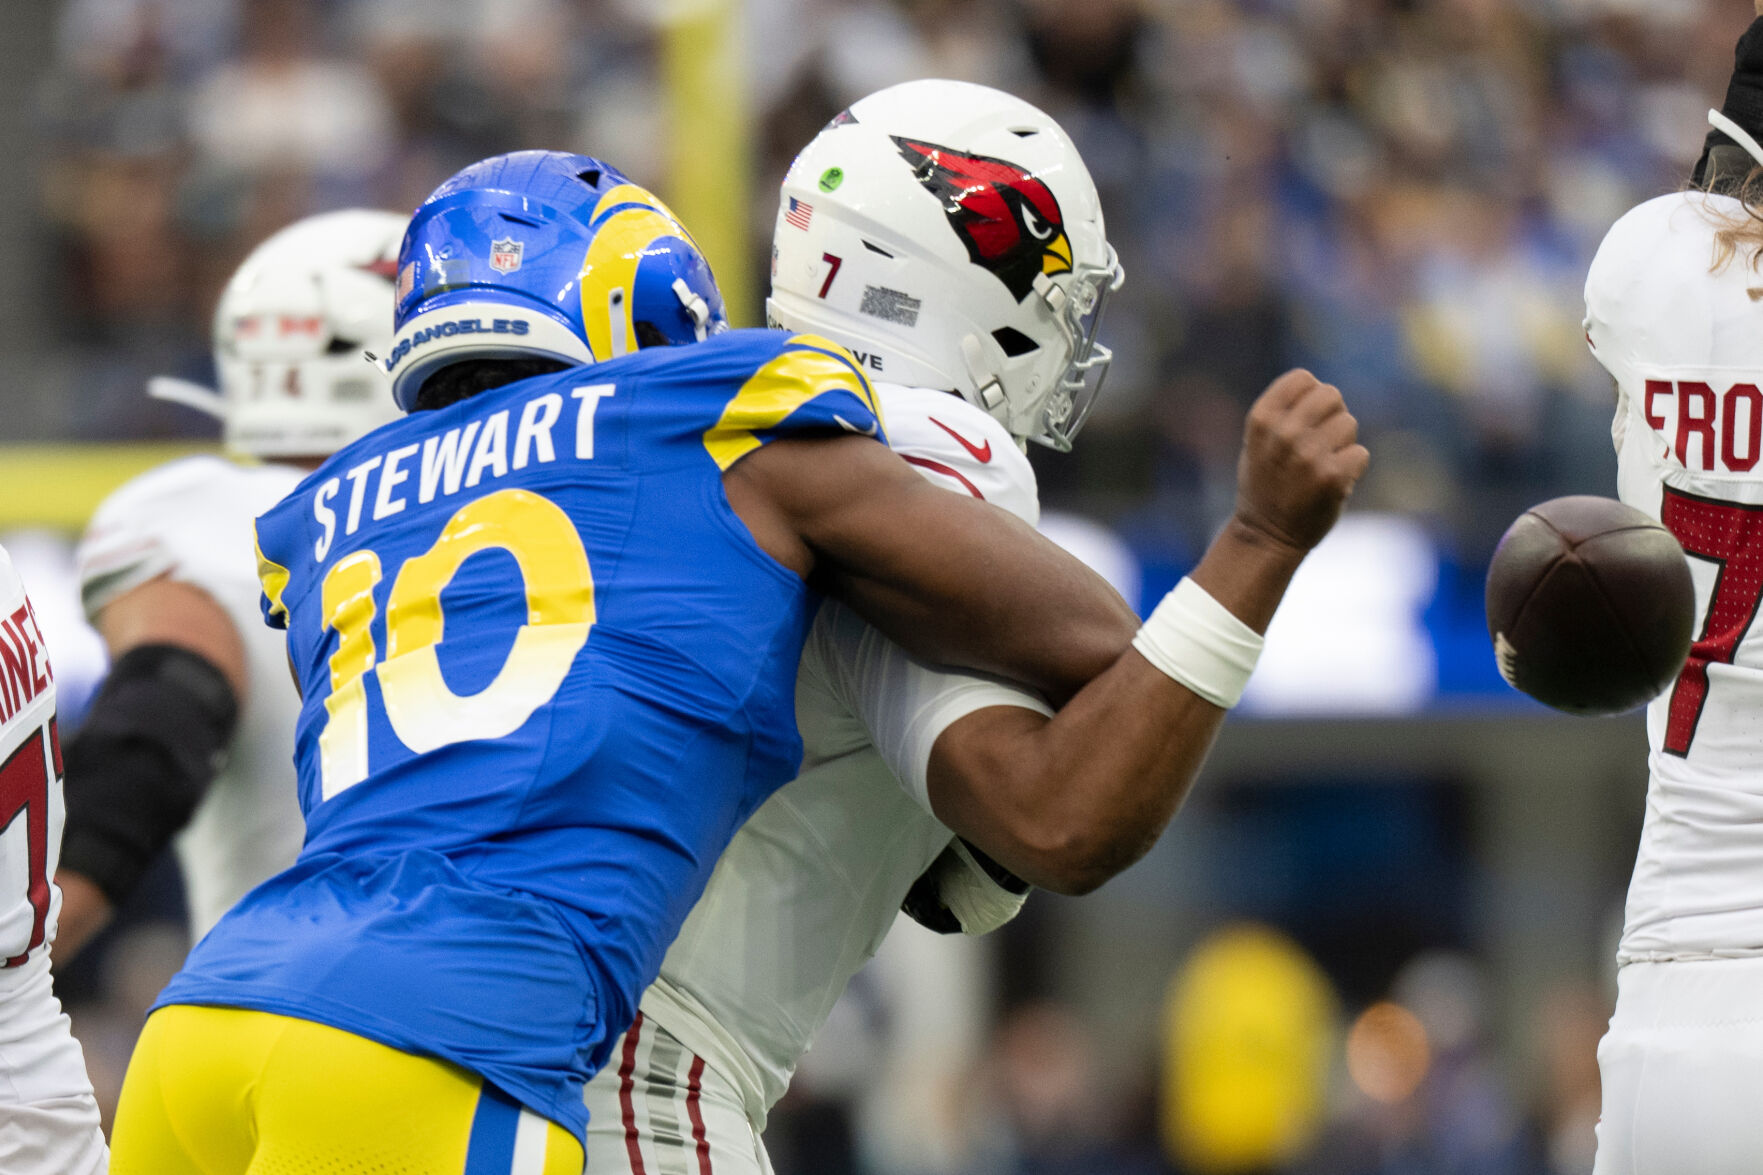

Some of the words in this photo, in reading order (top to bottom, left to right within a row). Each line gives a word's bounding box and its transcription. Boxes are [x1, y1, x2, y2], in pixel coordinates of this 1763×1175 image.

[494, 252, 519, 269] NFL
[818, 252, 842, 299] 7
[385, 338, 411, 372] LOS
[412, 318, 530, 348] ANGELES
[842, 346, 884, 372] VE
[314, 383, 616, 563] STEWART
[318, 488, 597, 802] 10
